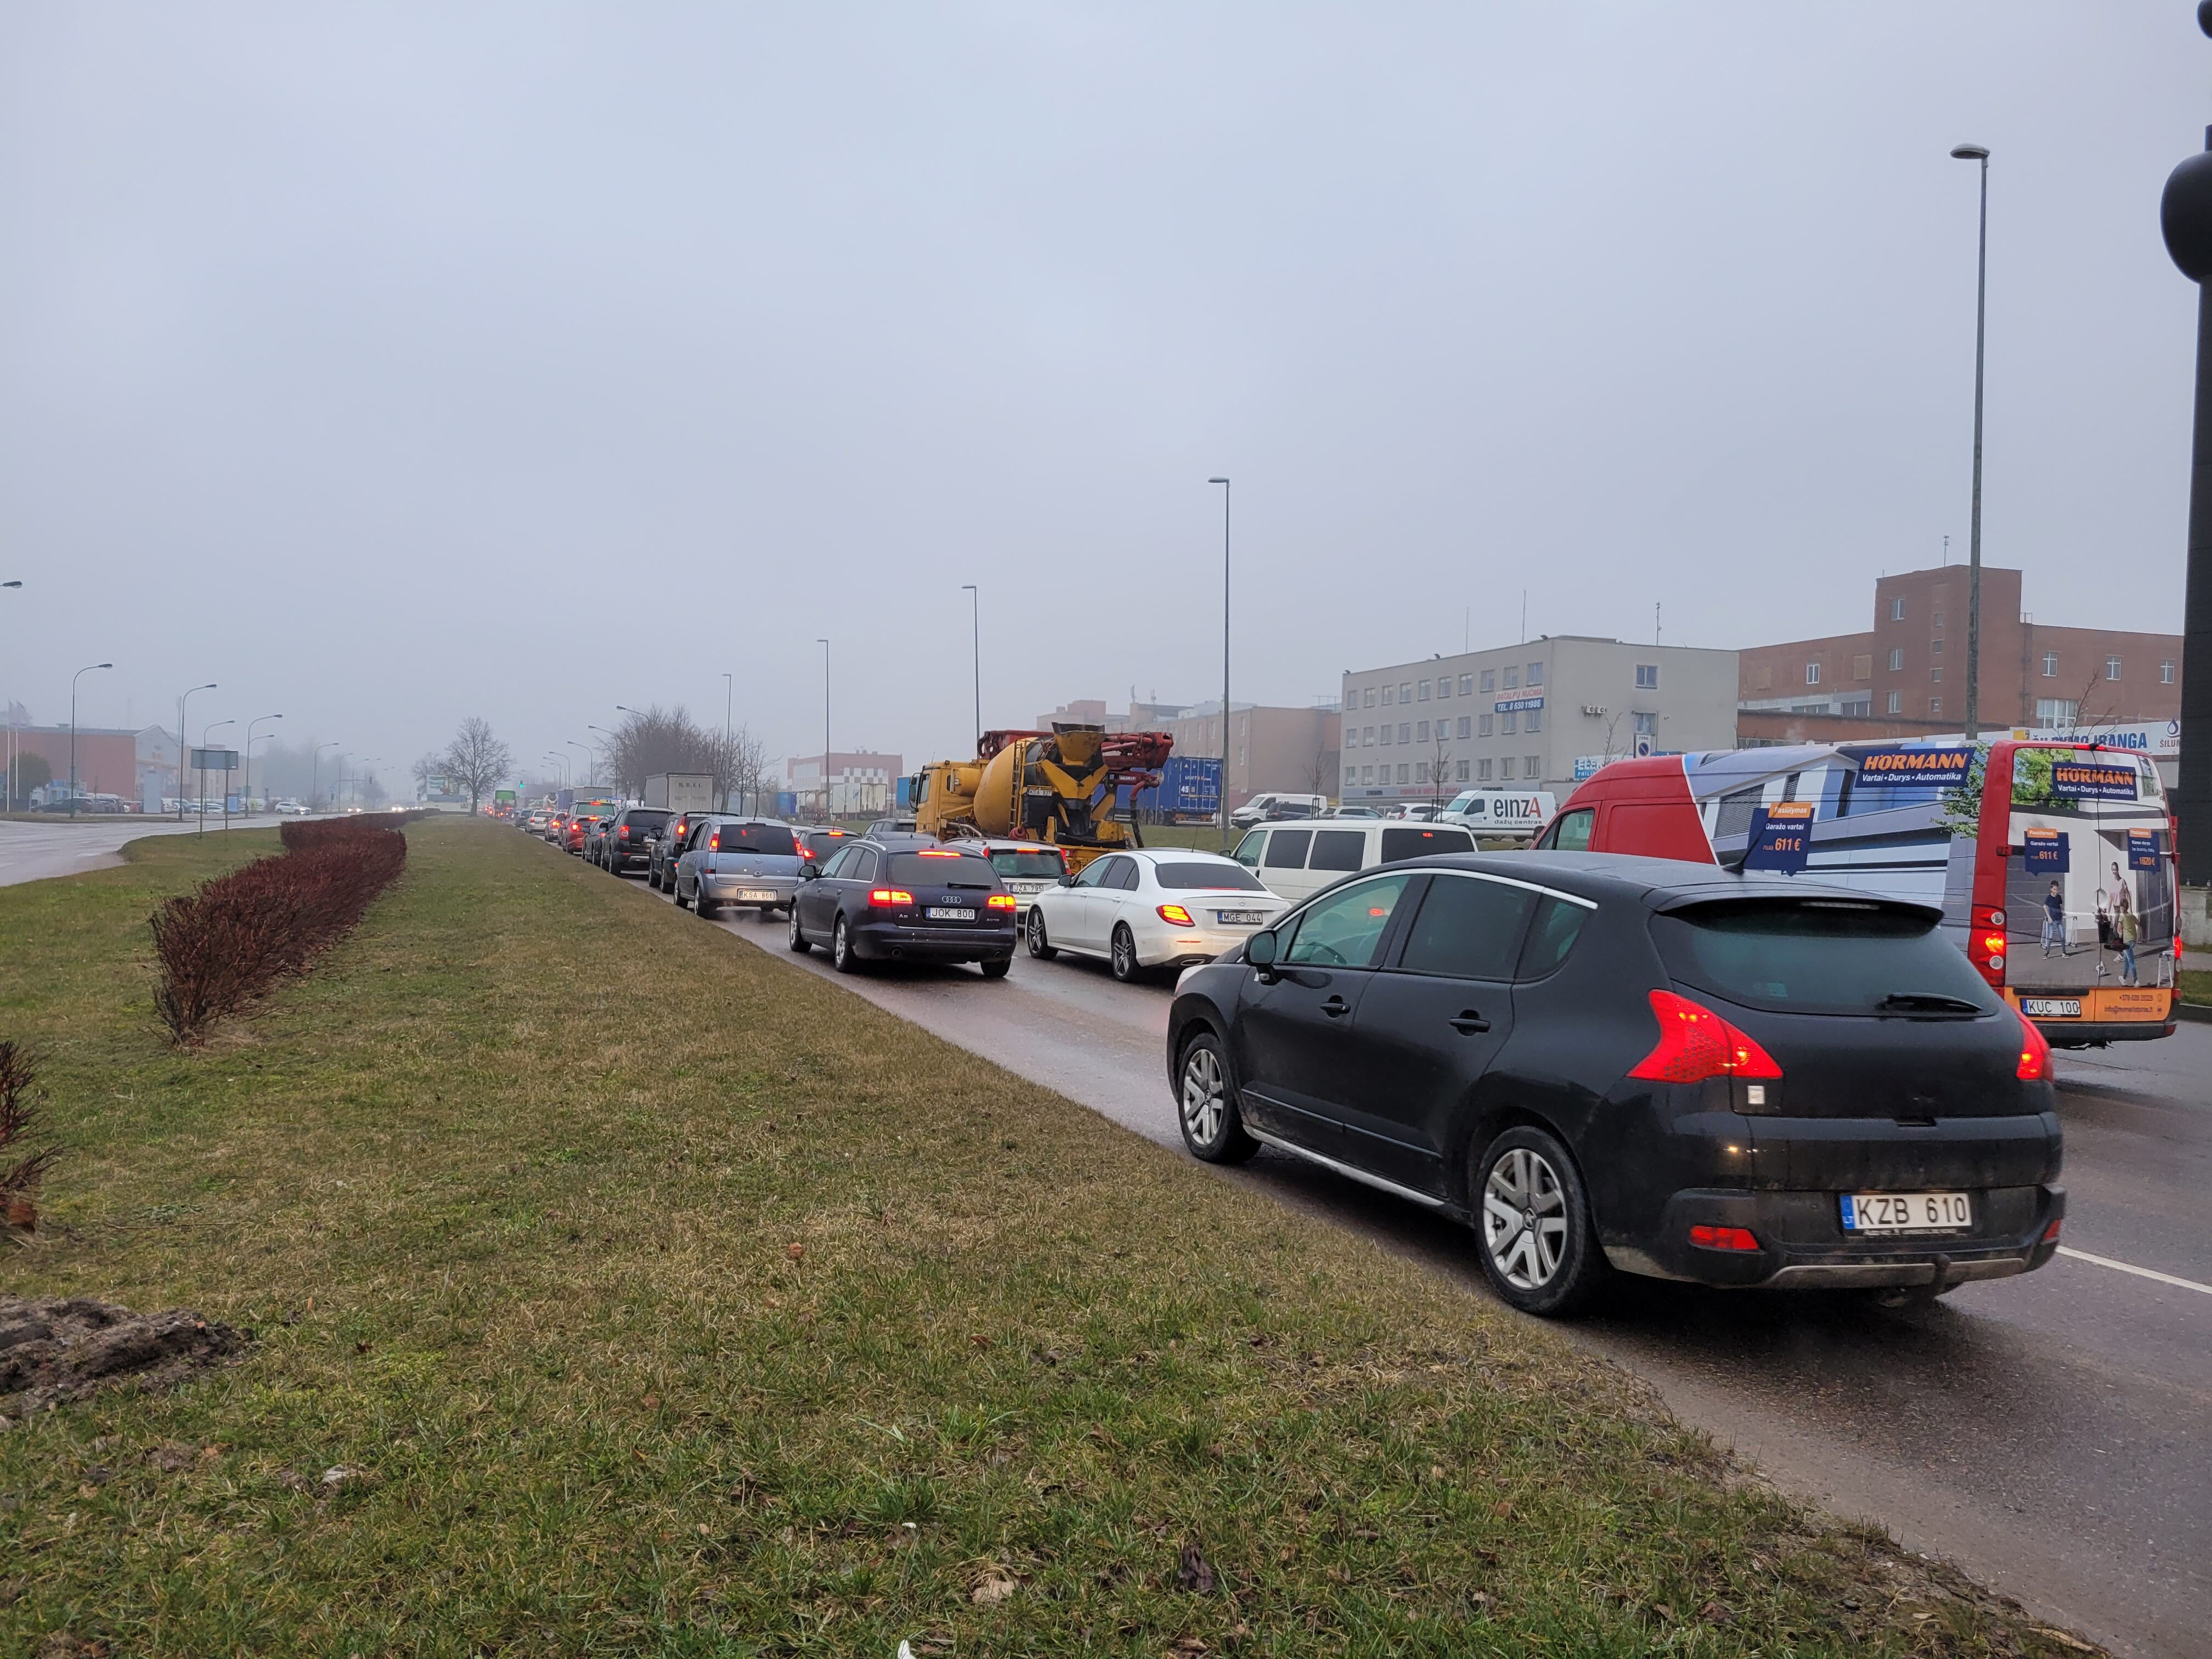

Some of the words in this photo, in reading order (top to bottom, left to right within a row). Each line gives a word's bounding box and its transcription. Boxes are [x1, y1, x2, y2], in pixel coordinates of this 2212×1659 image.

[1521, 688, 1542, 697] NUOMA
[1498, 703, 1508, 711] TEL.
[1509, 702, 1513, 710] 8
[1514, 701, 1524, 709] 650
[1864, 753, 1967, 771] HÖRMANN
[1863, 774, 1883, 782] Vartai
[1888, 773, 1910, 783] Durys
[1915, 772, 1961, 781] Automatika
[2057, 768, 2133, 786] HÖRMANN
[2058, 784, 2077, 792] Vartai
[2081, 785, 2098, 794] Durys
[2102, 786, 2134, 795] Automatika
[1775, 838, 1792, 851] 611
[1794, 838, 1802, 851] €
[2039, 851, 2052, 860] 611
[2053, 851, 2058, 860] €
[932, 909, 951, 918] JOK
[957, 910, 973, 918] 800
[1223, 913, 1241, 922] MGE
[1246, 913, 1261, 922] 044
[2028, 1000, 2052, 1013] KUC
[2059, 1001, 2079, 1013] 100
[1857, 1197, 1910, 1225] KZB
[1926, 1196, 1967, 1223] 610
